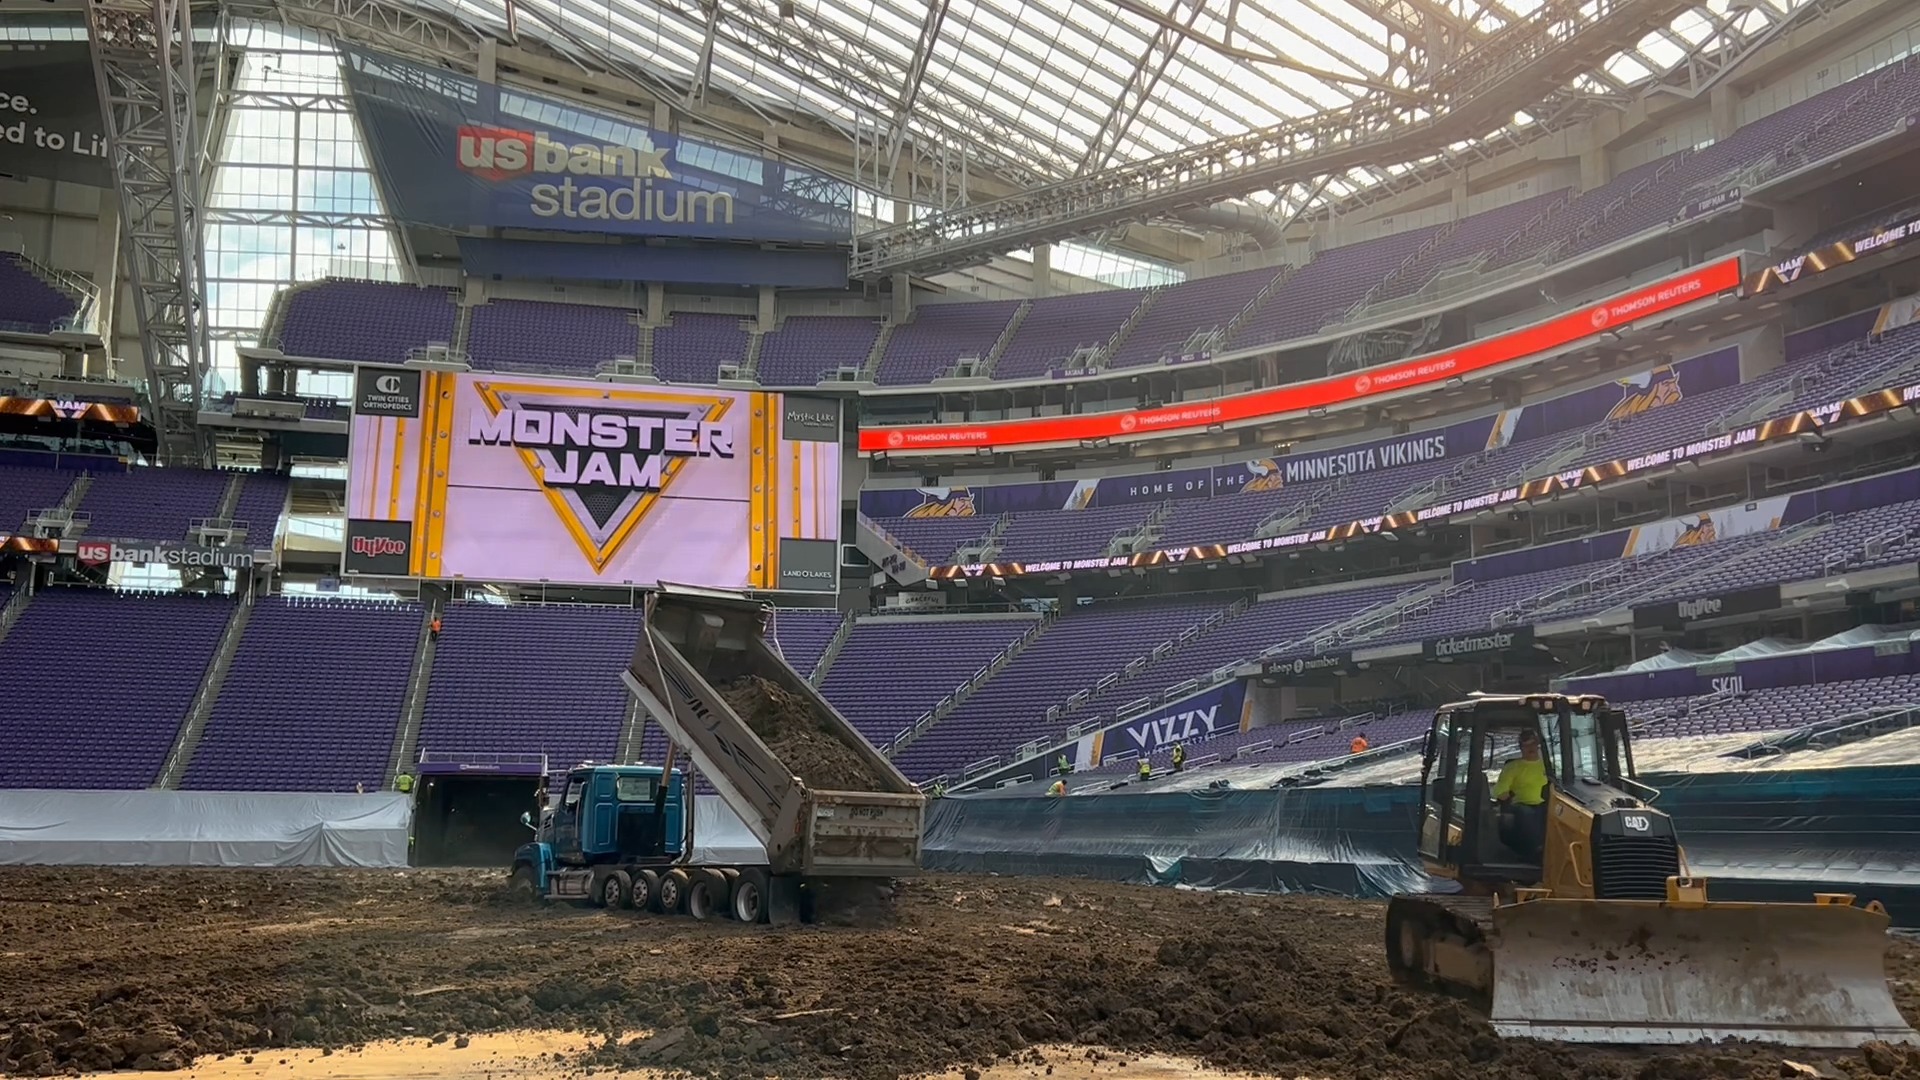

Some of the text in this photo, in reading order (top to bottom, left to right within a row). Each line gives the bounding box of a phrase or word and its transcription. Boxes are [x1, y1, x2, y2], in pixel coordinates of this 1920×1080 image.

[34, 126, 65, 150] to
[530, 177, 733, 224] stadium
[1855, 219, 1920, 253] WELCOME TO
[1610, 279, 1702, 317] THOMSON REUTERS
[1373, 359, 1457, 385] THOMSON REUTERS
[56, 400, 86, 410] JAM
[363, 401, 412, 410] ORTHOPEDICS
[367, 394, 409, 403] TWIN CITIES
[1813, 401, 1840, 417] JAM
[1139, 407, 1221, 425] THOMSON REUTERS
[468, 407, 735, 458] MONSTER
[906, 431, 988, 442] THOMSON REUTERS
[1286, 435, 1446, 483] MINNESOTA VIKINGS
[1627, 428, 1757, 471] WELCOME TO MONSTER JAM
[542, 450, 662, 491] JAM
[1560, 469, 1583, 481] JAM
[1130, 475, 1245, 496] HOME OF THE
[1417, 488, 1518, 520] WELCOME TO MONSTER JAM
[1227, 530, 1327, 554] WELCOME TO MONSTER JAM
[1025, 556, 1129, 573] WELCOME TO MONSTER JAM
[1434, 630, 1515, 657] ticketmaster
[1268, 655, 1340, 675] sleep number
[1711, 676, 1746, 696] SKOL
[1126, 705, 1218, 748] VIZZY
[1624, 816, 1649, 831] CAT
